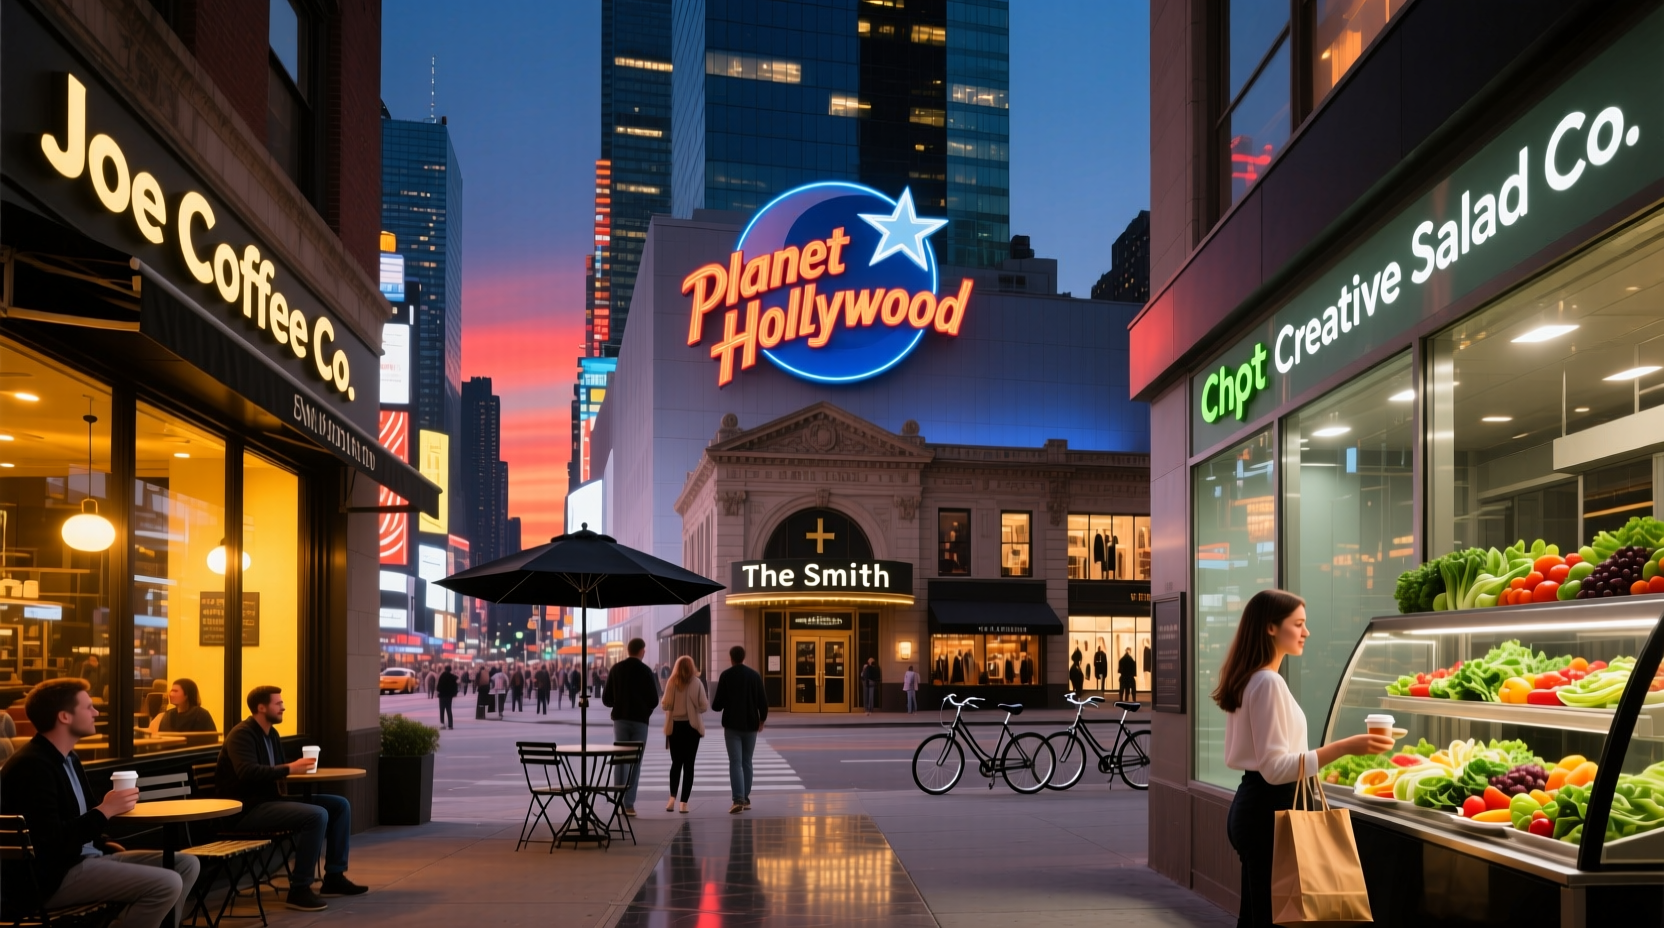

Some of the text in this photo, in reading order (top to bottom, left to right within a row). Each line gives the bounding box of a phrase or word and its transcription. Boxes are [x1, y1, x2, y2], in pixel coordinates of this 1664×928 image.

[40, 73, 356, 402] Joe Coffee Co.
[681, 226, 850, 347] Planet
[1274, 261, 1402, 375] Creative
[1410, 145, 1529, 285] Salad
[1544, 106, 1640, 192] Co.
[710, 278, 974, 387] Hollywood
[742, 562, 889, 588] The Smith
